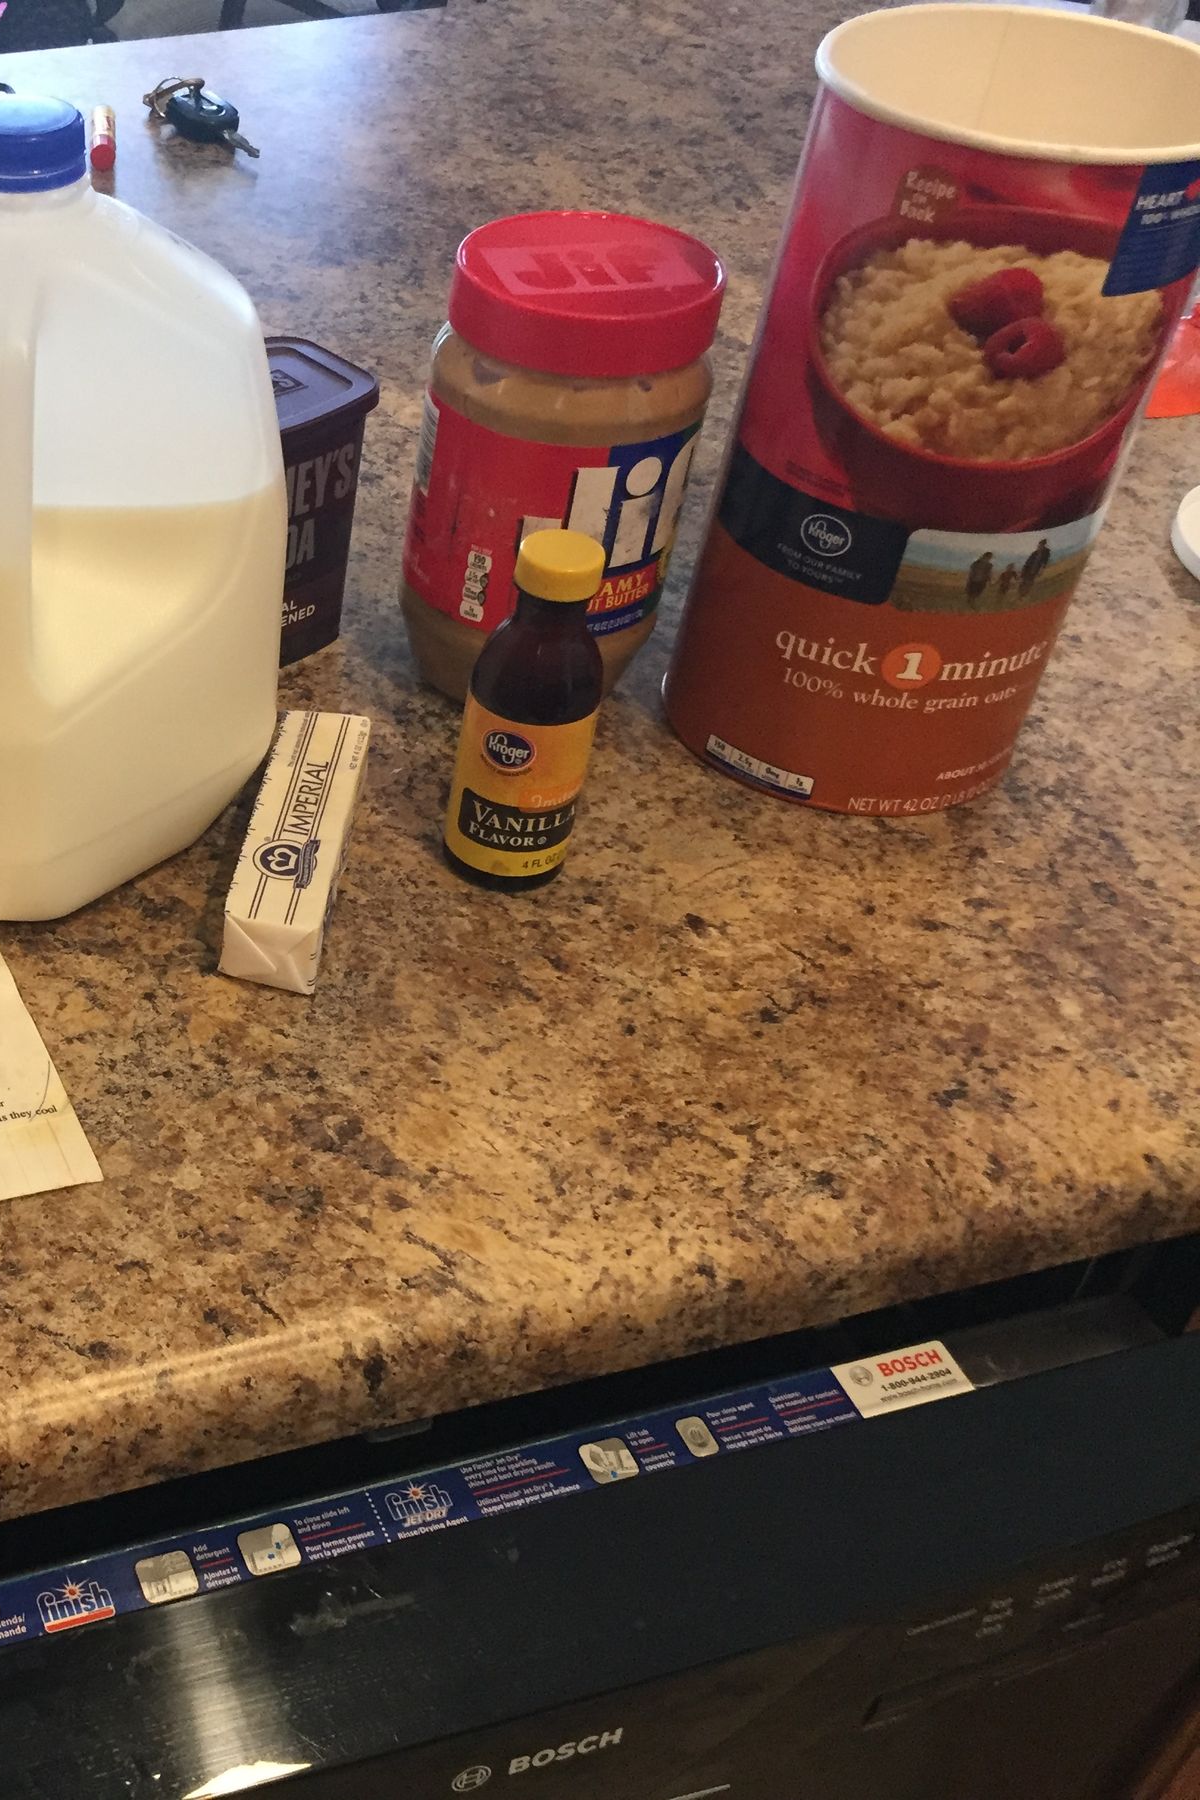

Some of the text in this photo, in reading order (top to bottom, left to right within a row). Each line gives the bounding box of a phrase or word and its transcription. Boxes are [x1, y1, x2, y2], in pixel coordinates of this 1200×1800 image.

[906, 170, 956, 199] Recipe
[1135, 190, 1184, 211] HEART
[808, 520, 845, 549] Kroger
[777, 543, 862, 580] FROM OUR FAMILY
[605, 584, 649, 609] BUTTER
[775, 630, 877, 676] quick
[896, 652, 923, 681] 1
[783, 667, 844, 699] 100%
[853, 688, 918, 709] whole
[925, 692, 979, 713] grain
[489, 734, 530, 764] Kroger
[936, 766, 976, 781] ABOUT
[283, 761, 329, 836] IMPERIAL
[848, 797, 876, 811] NET
[879, 800, 901, 812] WT
[903, 799, 917, 812] 42
[920, 797, 939, 810] OZ
[473, 800, 576, 832] VANILLA
[469, 821, 534, 846] FLAVOR
[522, 861, 529, 869] 4
[531, 857, 543, 868] FL
[9, 1109, 32, 1120] they
[35, 1104, 58, 1115] cool
[877, 1349, 943, 1377] BOSCH
[625, 1428, 650, 1440] Lift tab
[385, 1484, 454, 1521] finish
[293, 1506, 350, 1527] To close slide left
[297, 1520, 332, 1534] and down
[397, 1515, 470, 1541] Rinse/Drying Agent
[193, 1543, 208, 1553] Add
[195, 1547, 230, 1561] detergent
[305, 1530, 375, 1553] Pour poussez
[308, 1552, 324, 1561] vers
[331, 1544, 357, 1559] gauche
[357, 1541, 365, 1549] et
[203, 1568, 231, 1582] Ajoutez
[36, 1581, 115, 1624] finish
[508, 1727, 623, 1775] BOSCH
